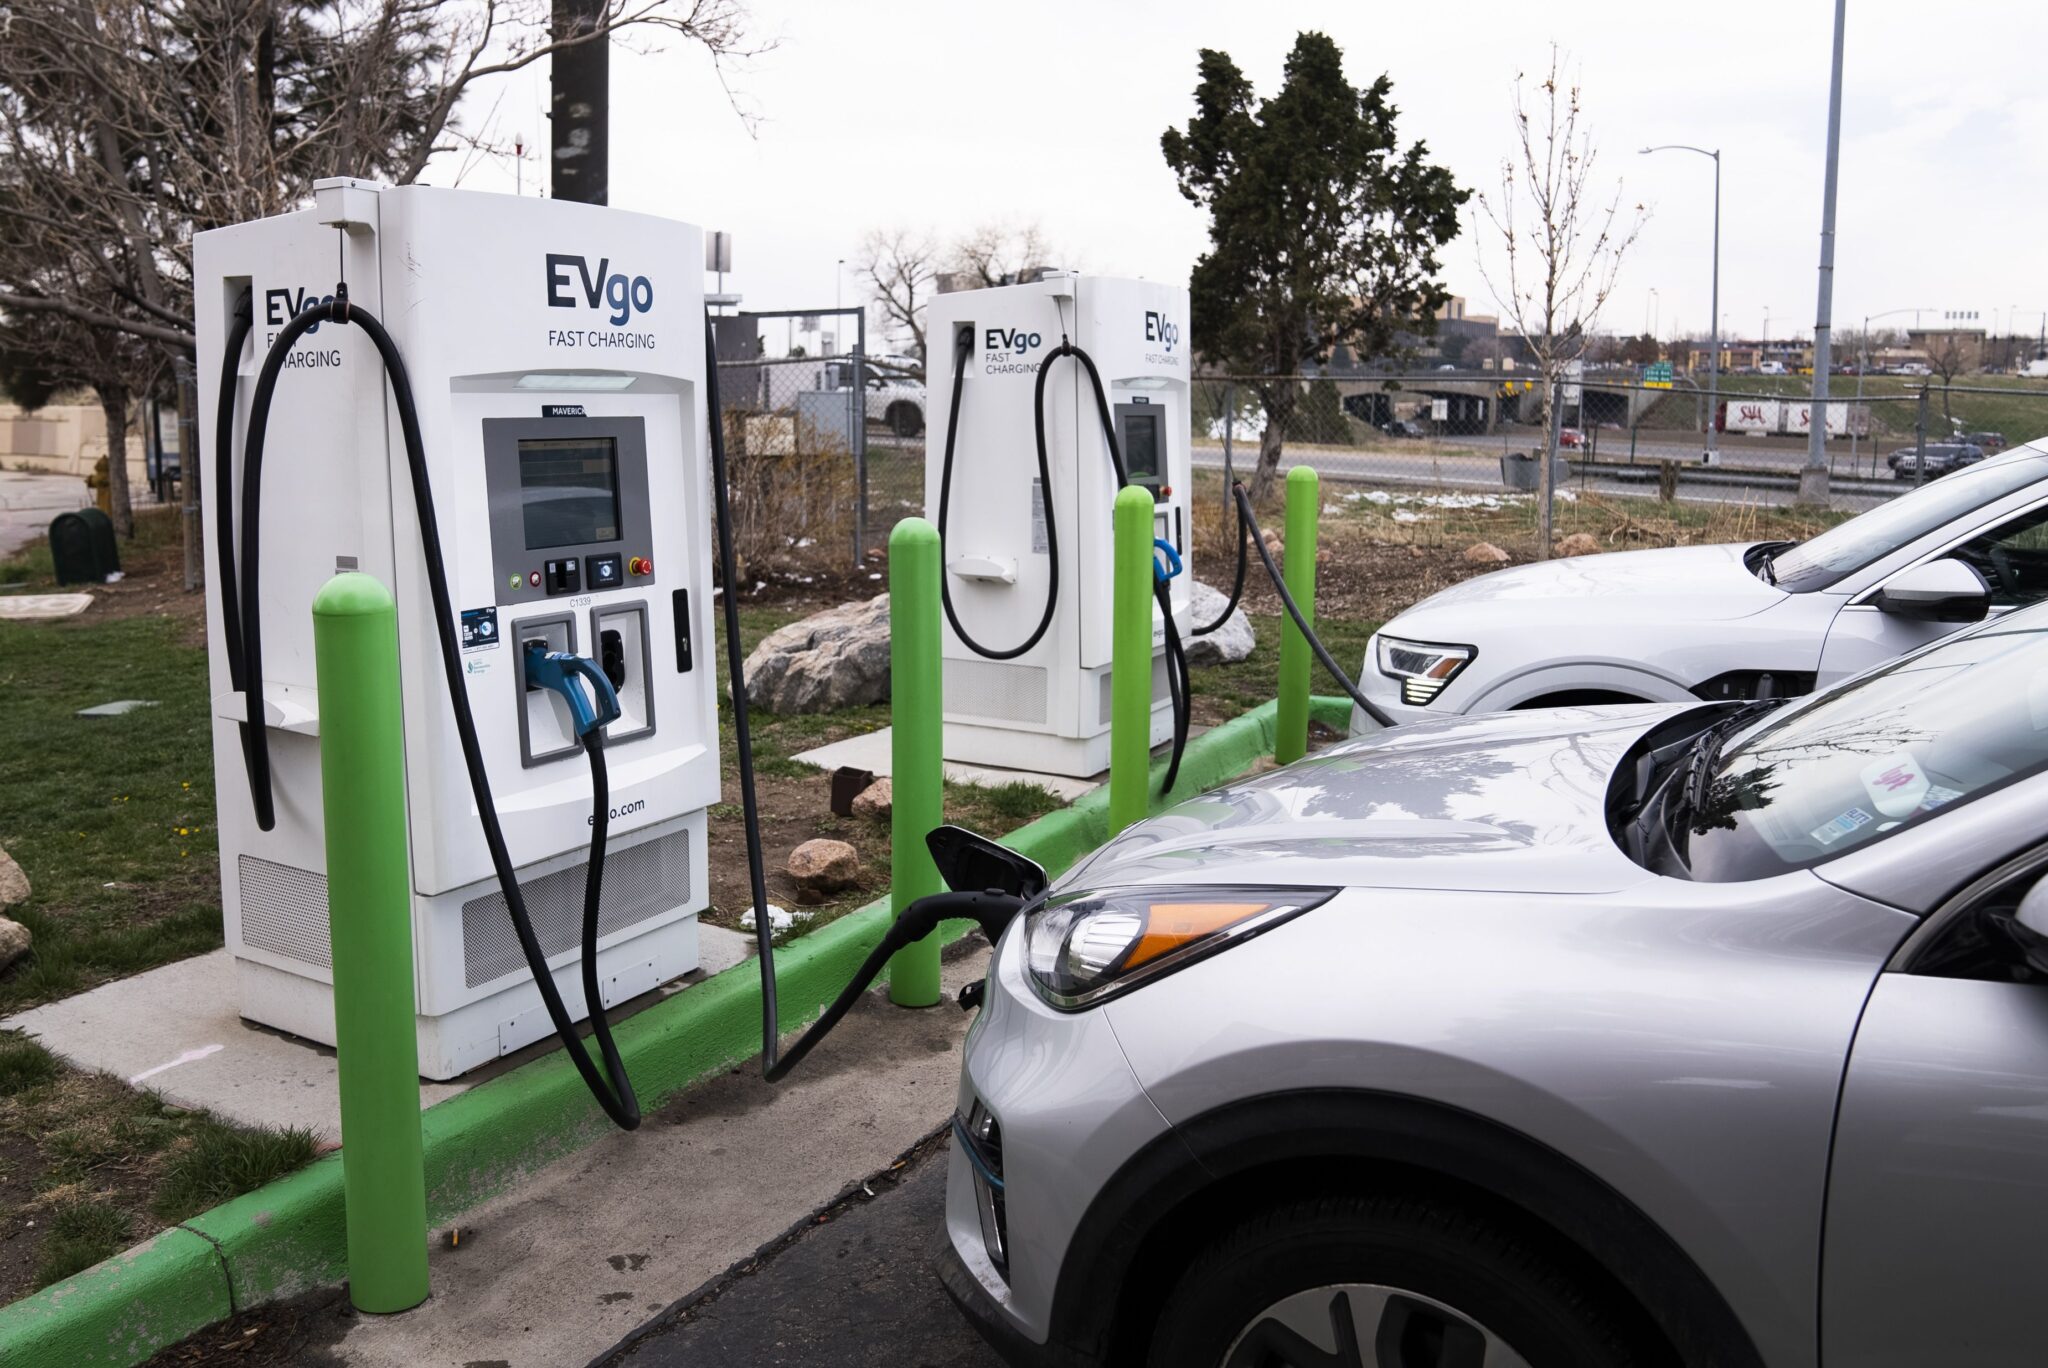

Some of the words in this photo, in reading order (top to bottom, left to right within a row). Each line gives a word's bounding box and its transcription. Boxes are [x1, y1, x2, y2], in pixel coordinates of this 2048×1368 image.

[545, 253, 653, 327] EVgo
[549, 330, 585, 347] FAST
[588, 331, 655, 349] CHARGING
[986, 328, 1042, 355] EVgo
[1145, 310, 1178, 352] EVgo
[284, 350, 341, 369] ARGING
[986, 353, 1011, 363] FAST
[570, 596, 591, 608] C1339
[587, 799, 645, 826] eo.com
